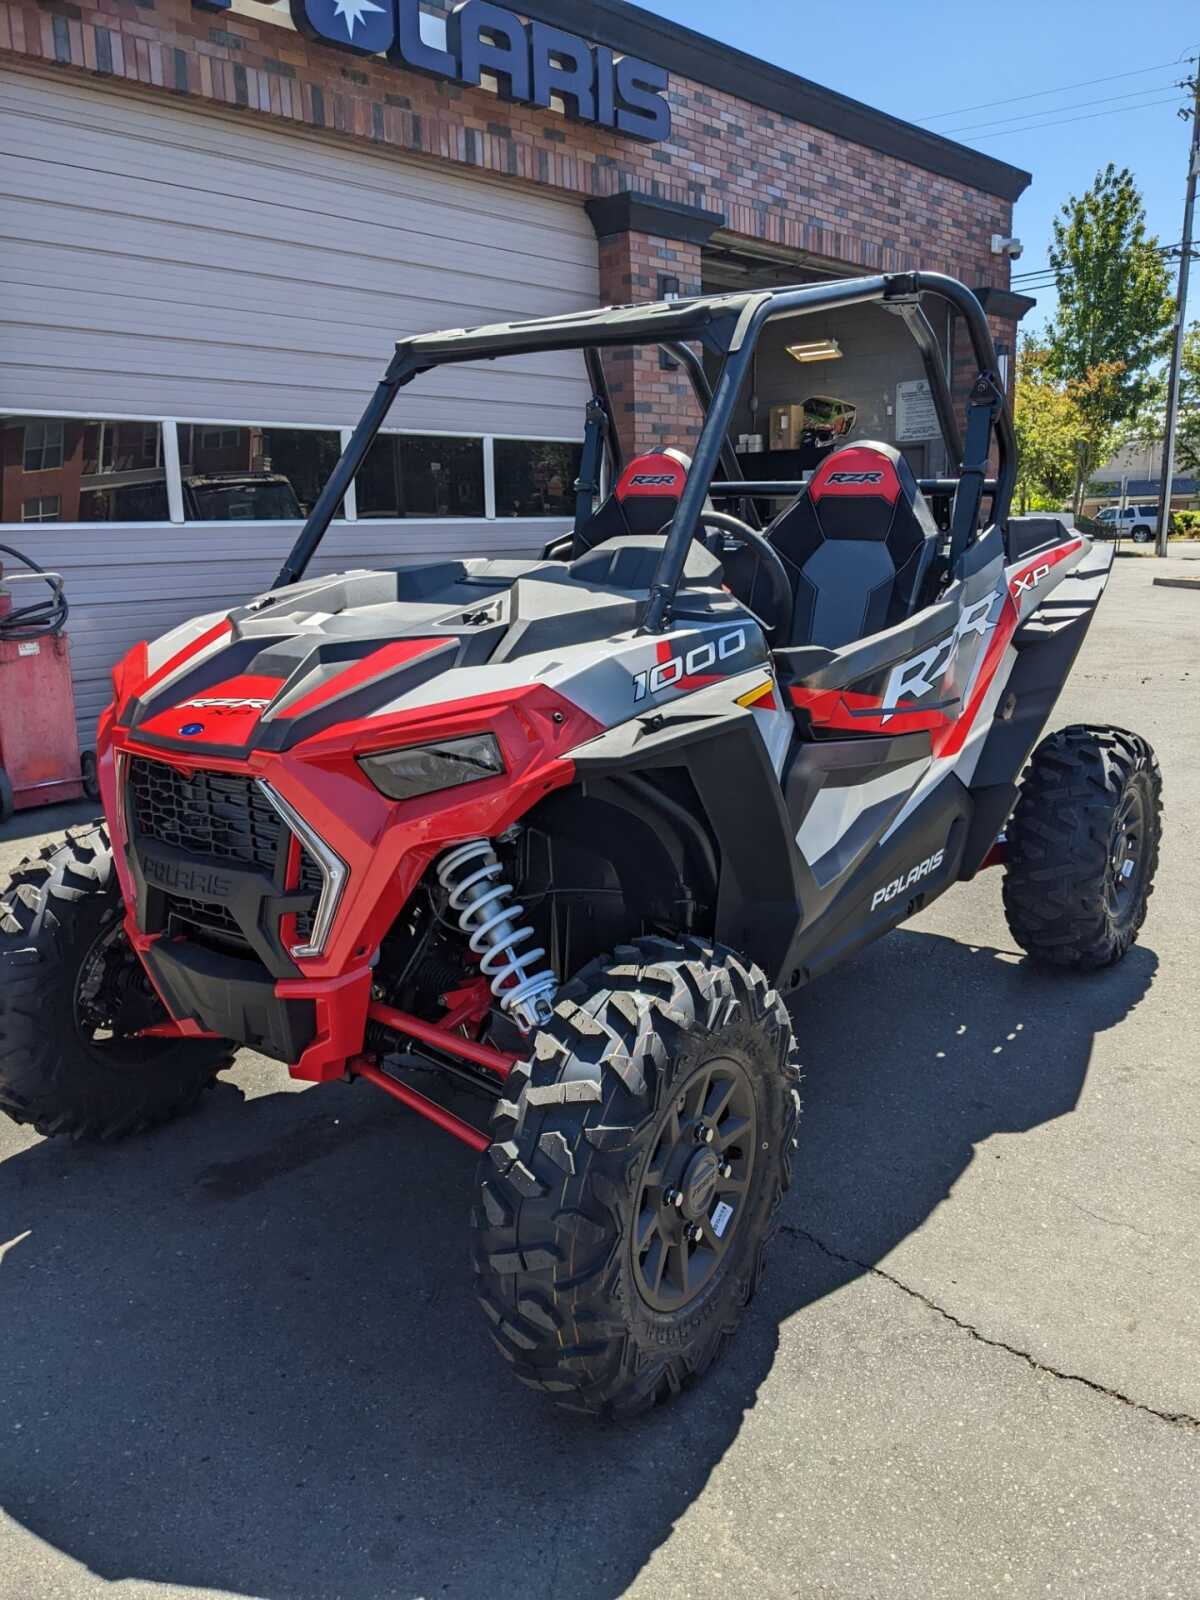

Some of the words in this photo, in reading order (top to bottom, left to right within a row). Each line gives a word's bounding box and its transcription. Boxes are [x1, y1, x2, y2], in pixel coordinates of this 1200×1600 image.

[192, 0, 671, 143] OLARIS
[629, 473, 676, 486] RZR
[825, 471, 883, 485] RZR
[1013, 563, 1050, 598] XP
[632, 628, 746, 703] 1000
[174, 698, 272, 710] RZR
[143, 857, 232, 896] POLARIS
[870, 847, 945, 912] POLARIS
